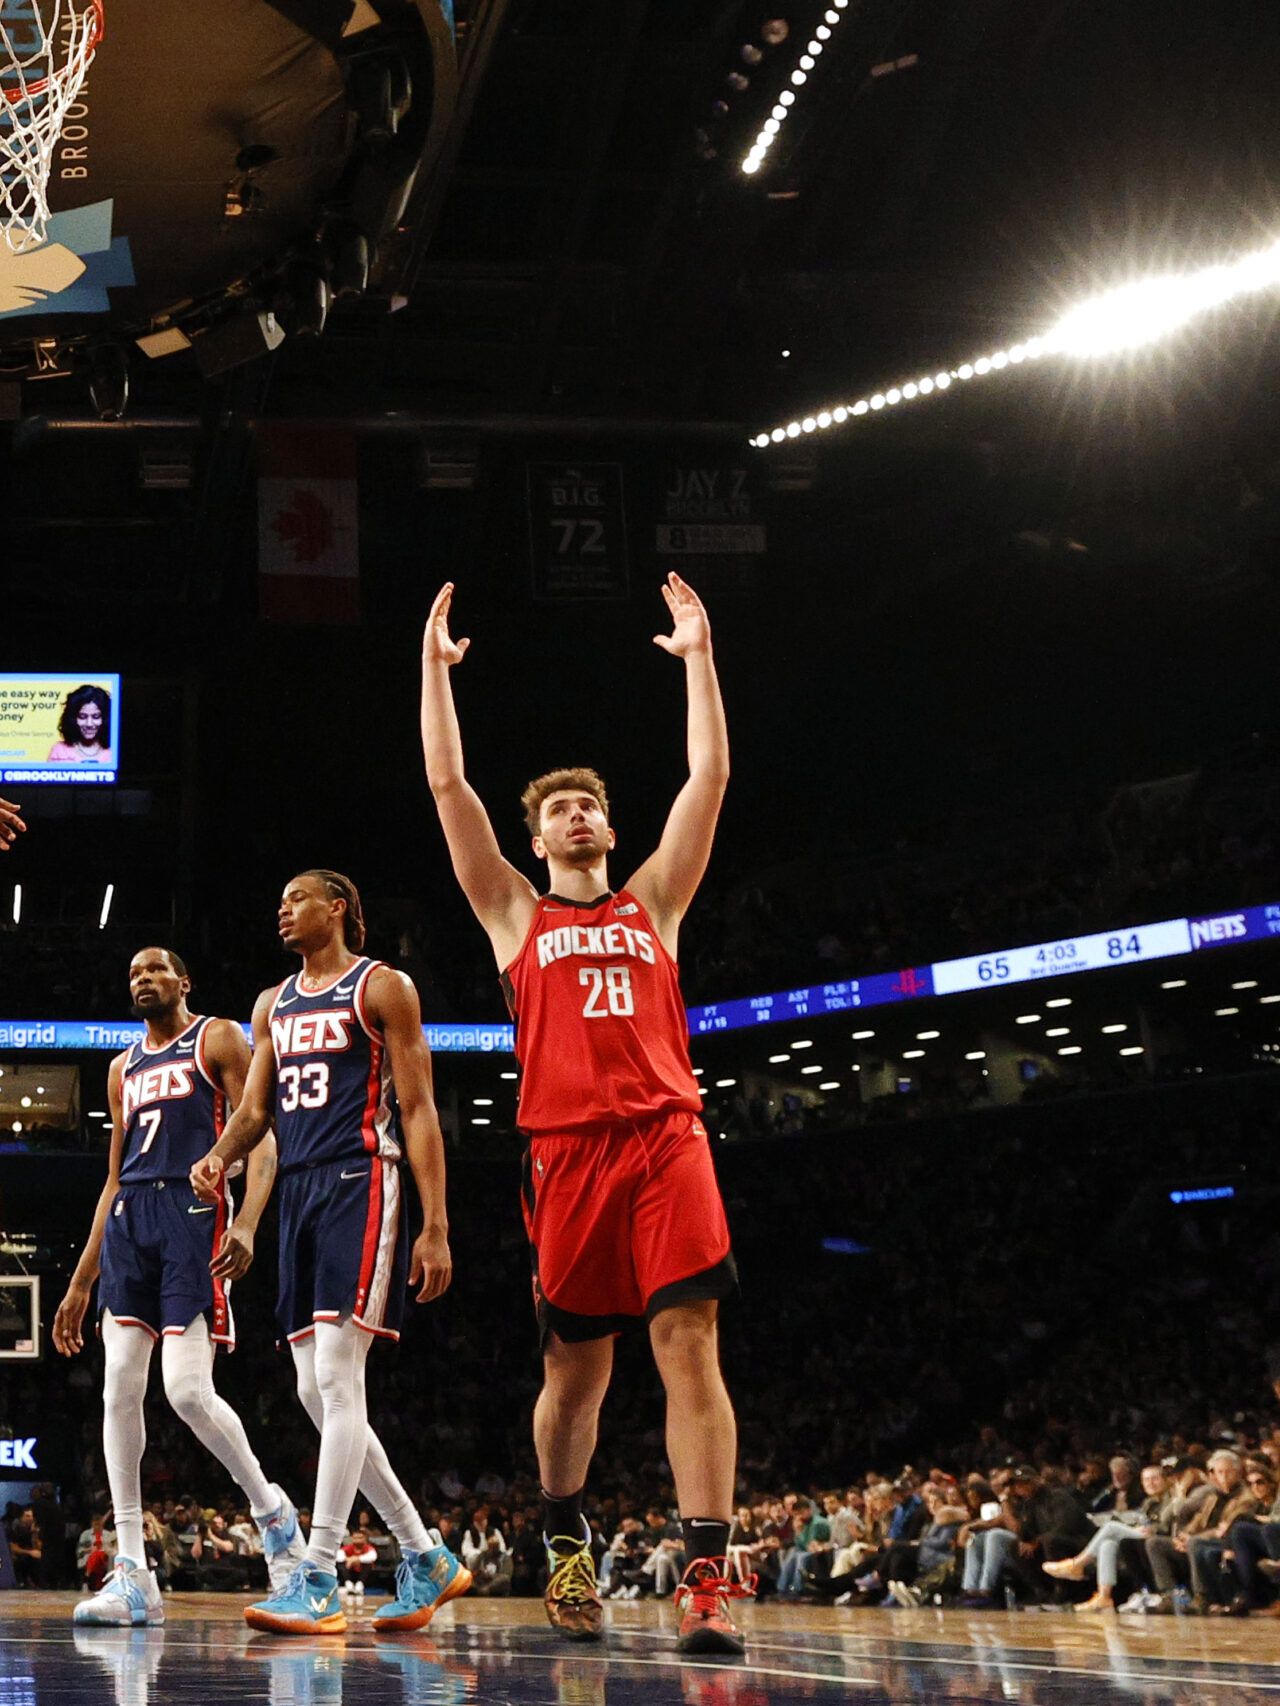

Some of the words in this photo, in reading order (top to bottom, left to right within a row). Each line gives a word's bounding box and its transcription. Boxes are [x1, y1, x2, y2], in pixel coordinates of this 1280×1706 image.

[61, 14, 89, 179] BROOKYN
[666, 469, 720, 499] JAY
[550, 518, 607, 554] 72
[0, 702, 29, 711] grow
[31, 702, 57, 711] your
[10, 690, 36, 700] easy
[38, 690, 61, 700] way
[536, 922, 656, 969] ROCKETS
[1190, 914, 1247, 950] NETS
[977, 957, 1010, 982] 65
[1035, 943, 1078, 963] 4:03
[1107, 933, 1142, 959] 84
[579, 966, 635, 1018] 28
[85, 1026, 144, 1044] Three
[271, 1010, 352, 1062] NETS
[426, 1026, 515, 1051] tionalgri
[122, 1061, 194, 1122] NETS
[279, 1063, 329, 1112] 33
[139, 1109, 161, 1153] 7
